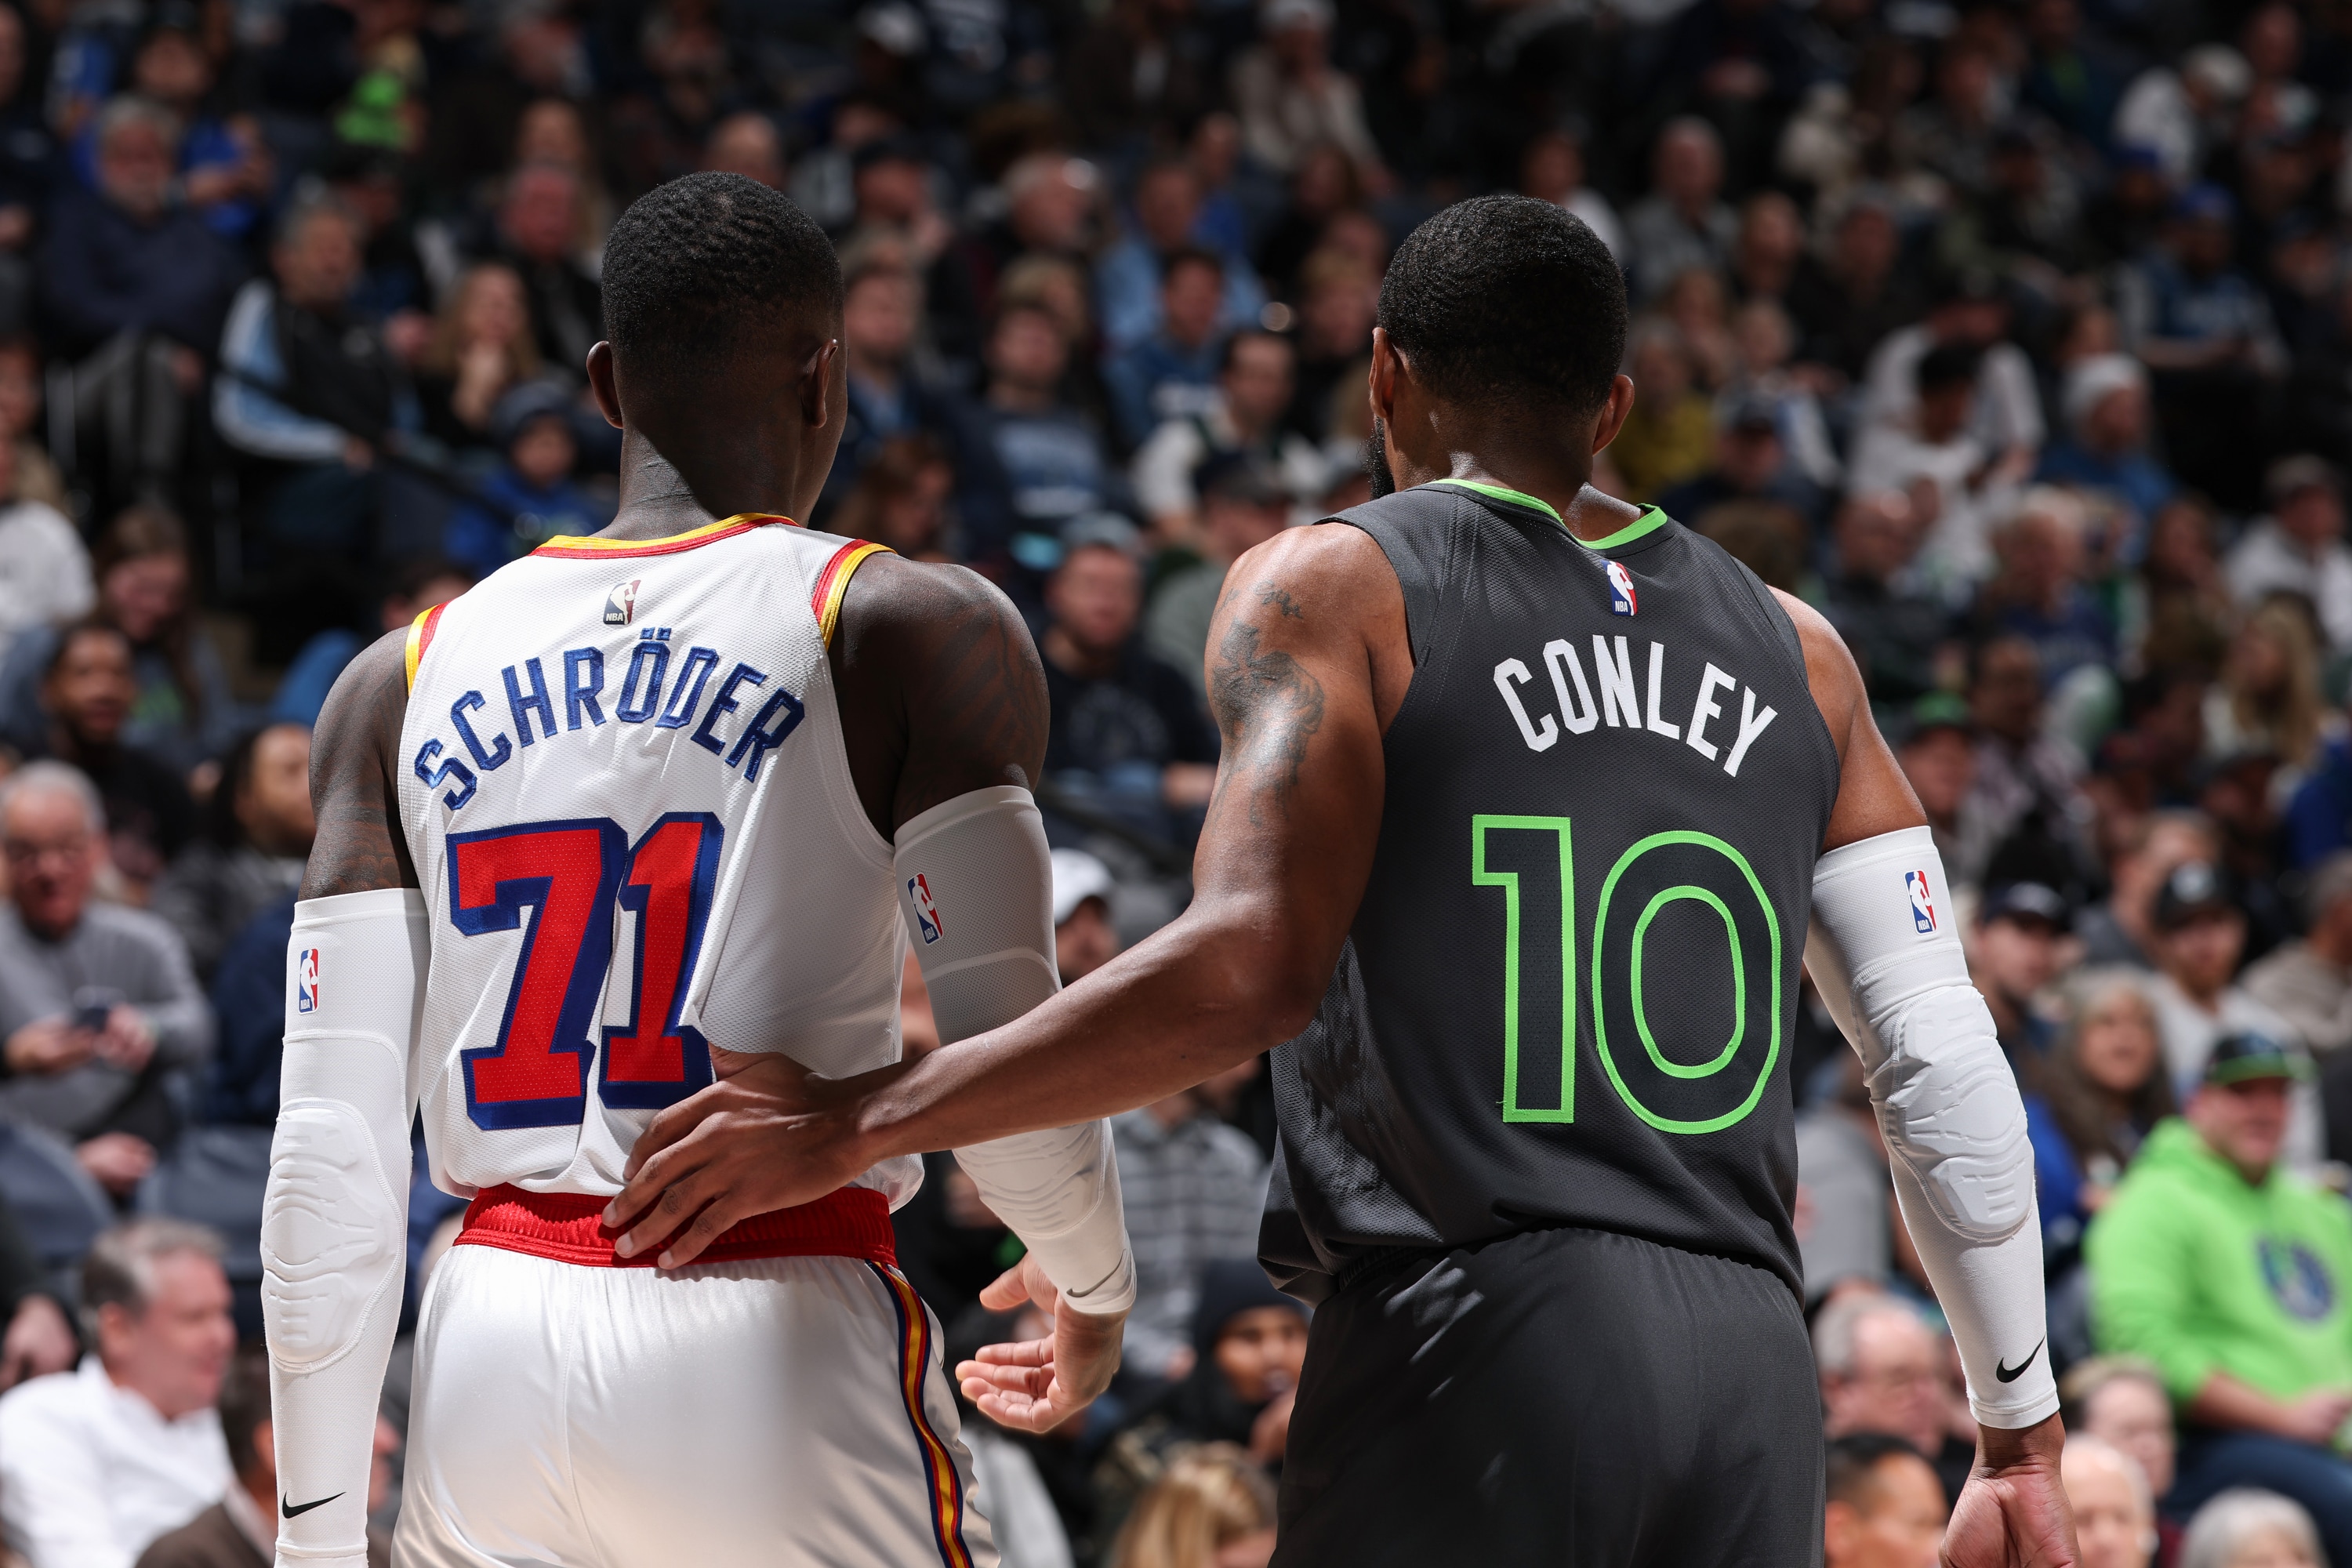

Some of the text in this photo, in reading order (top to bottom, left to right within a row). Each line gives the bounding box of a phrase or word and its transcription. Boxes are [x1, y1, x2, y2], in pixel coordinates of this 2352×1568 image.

[1615, 601, 1628, 612] NBA
[414, 627, 805, 811] SCHRÖDER
[1494, 634, 1778, 777] CONLEY
[924, 927, 935, 941] NBA
[1918, 920, 1929, 931] NBA
[300, 999, 310, 1010] NBA
[445, 811, 725, 1131] 71
[1472, 814, 1781, 1134] 10
